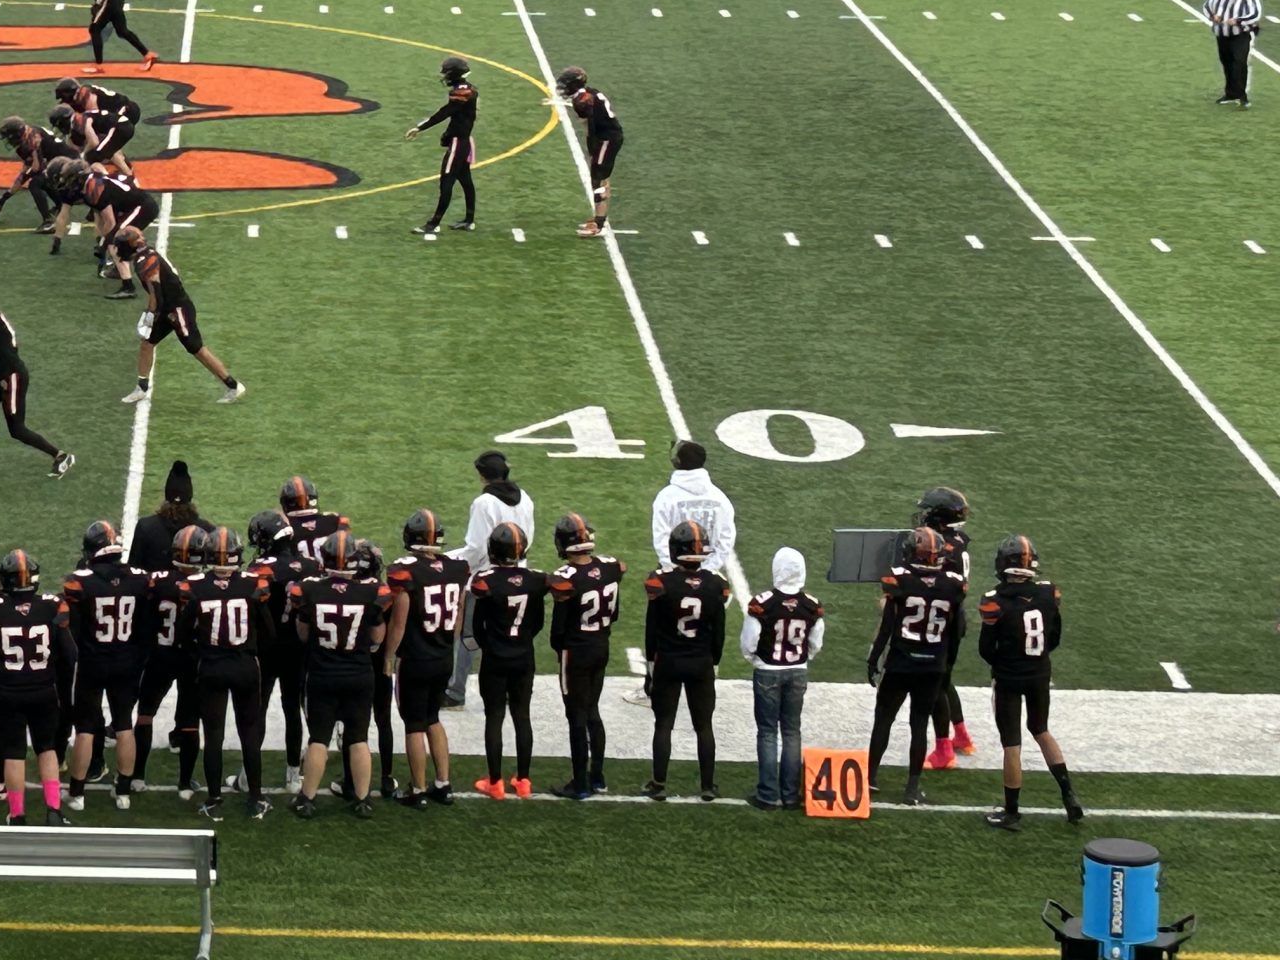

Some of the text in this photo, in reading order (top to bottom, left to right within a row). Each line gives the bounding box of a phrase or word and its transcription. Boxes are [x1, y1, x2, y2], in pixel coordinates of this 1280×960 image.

[95, 595, 136, 644] 58
[200, 598, 248, 646] 70
[315, 603, 365, 651] 57
[423, 582, 460, 633] 59
[507, 593, 529, 637] 7
[580, 581, 619, 632] 23
[676, 596, 703, 638] 2
[901, 596, 952, 644] 26
[0, 624, 51, 671] 53
[771, 618, 807, 663] 19
[1022, 608, 1045, 657] 8
[811, 757, 863, 812] 40
